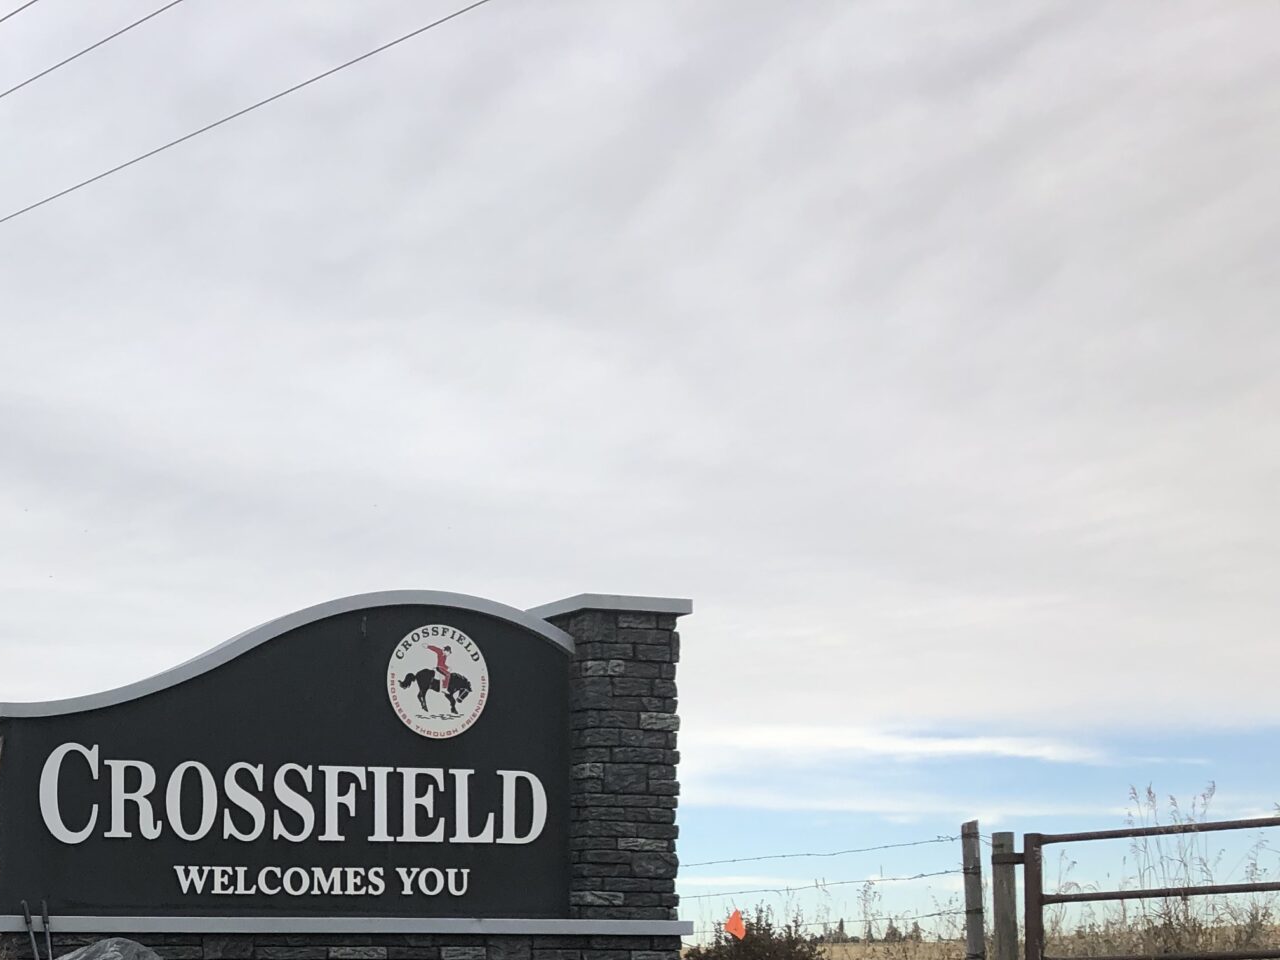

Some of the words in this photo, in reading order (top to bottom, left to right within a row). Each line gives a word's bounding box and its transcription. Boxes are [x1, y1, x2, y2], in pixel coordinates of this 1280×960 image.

[395, 626, 480, 662] CROSSFIELD
[415, 725, 458, 737] THROUGH
[461, 675, 486, 729] FRIENDSHIP
[39, 742, 548, 845] CROSSFIELD
[173, 864, 386, 896] WELCOMES
[397, 868, 470, 896] YOU
